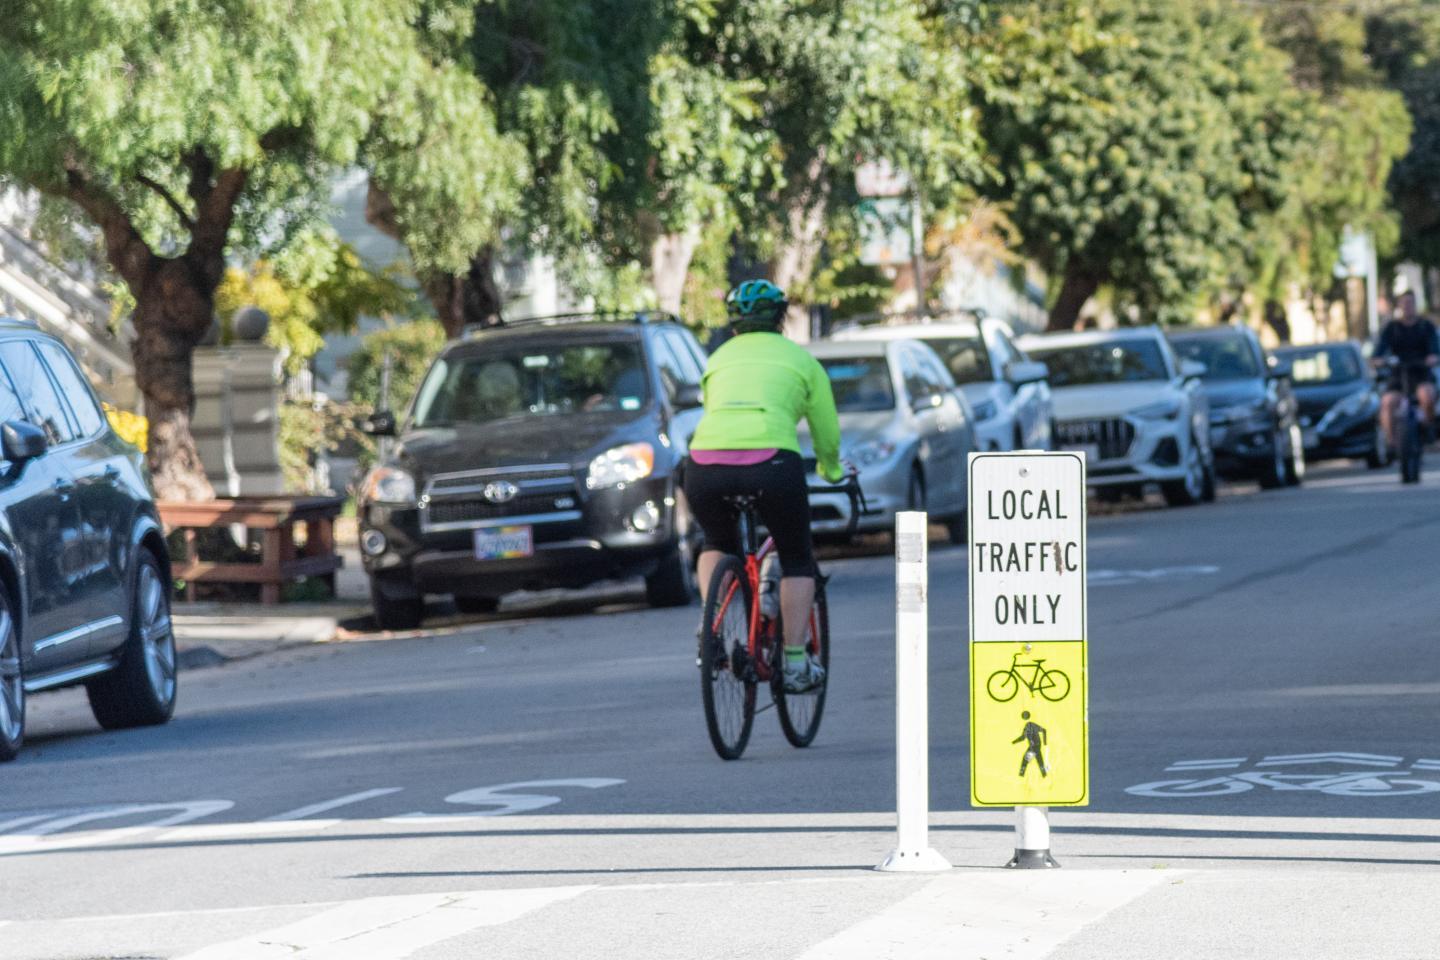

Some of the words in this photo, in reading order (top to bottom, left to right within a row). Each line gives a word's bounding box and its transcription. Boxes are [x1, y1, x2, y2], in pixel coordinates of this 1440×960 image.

[988, 490, 1067, 520] LOCAL
[976, 542, 1078, 573] TRAFFIC
[995, 594, 1061, 625] ONLY
